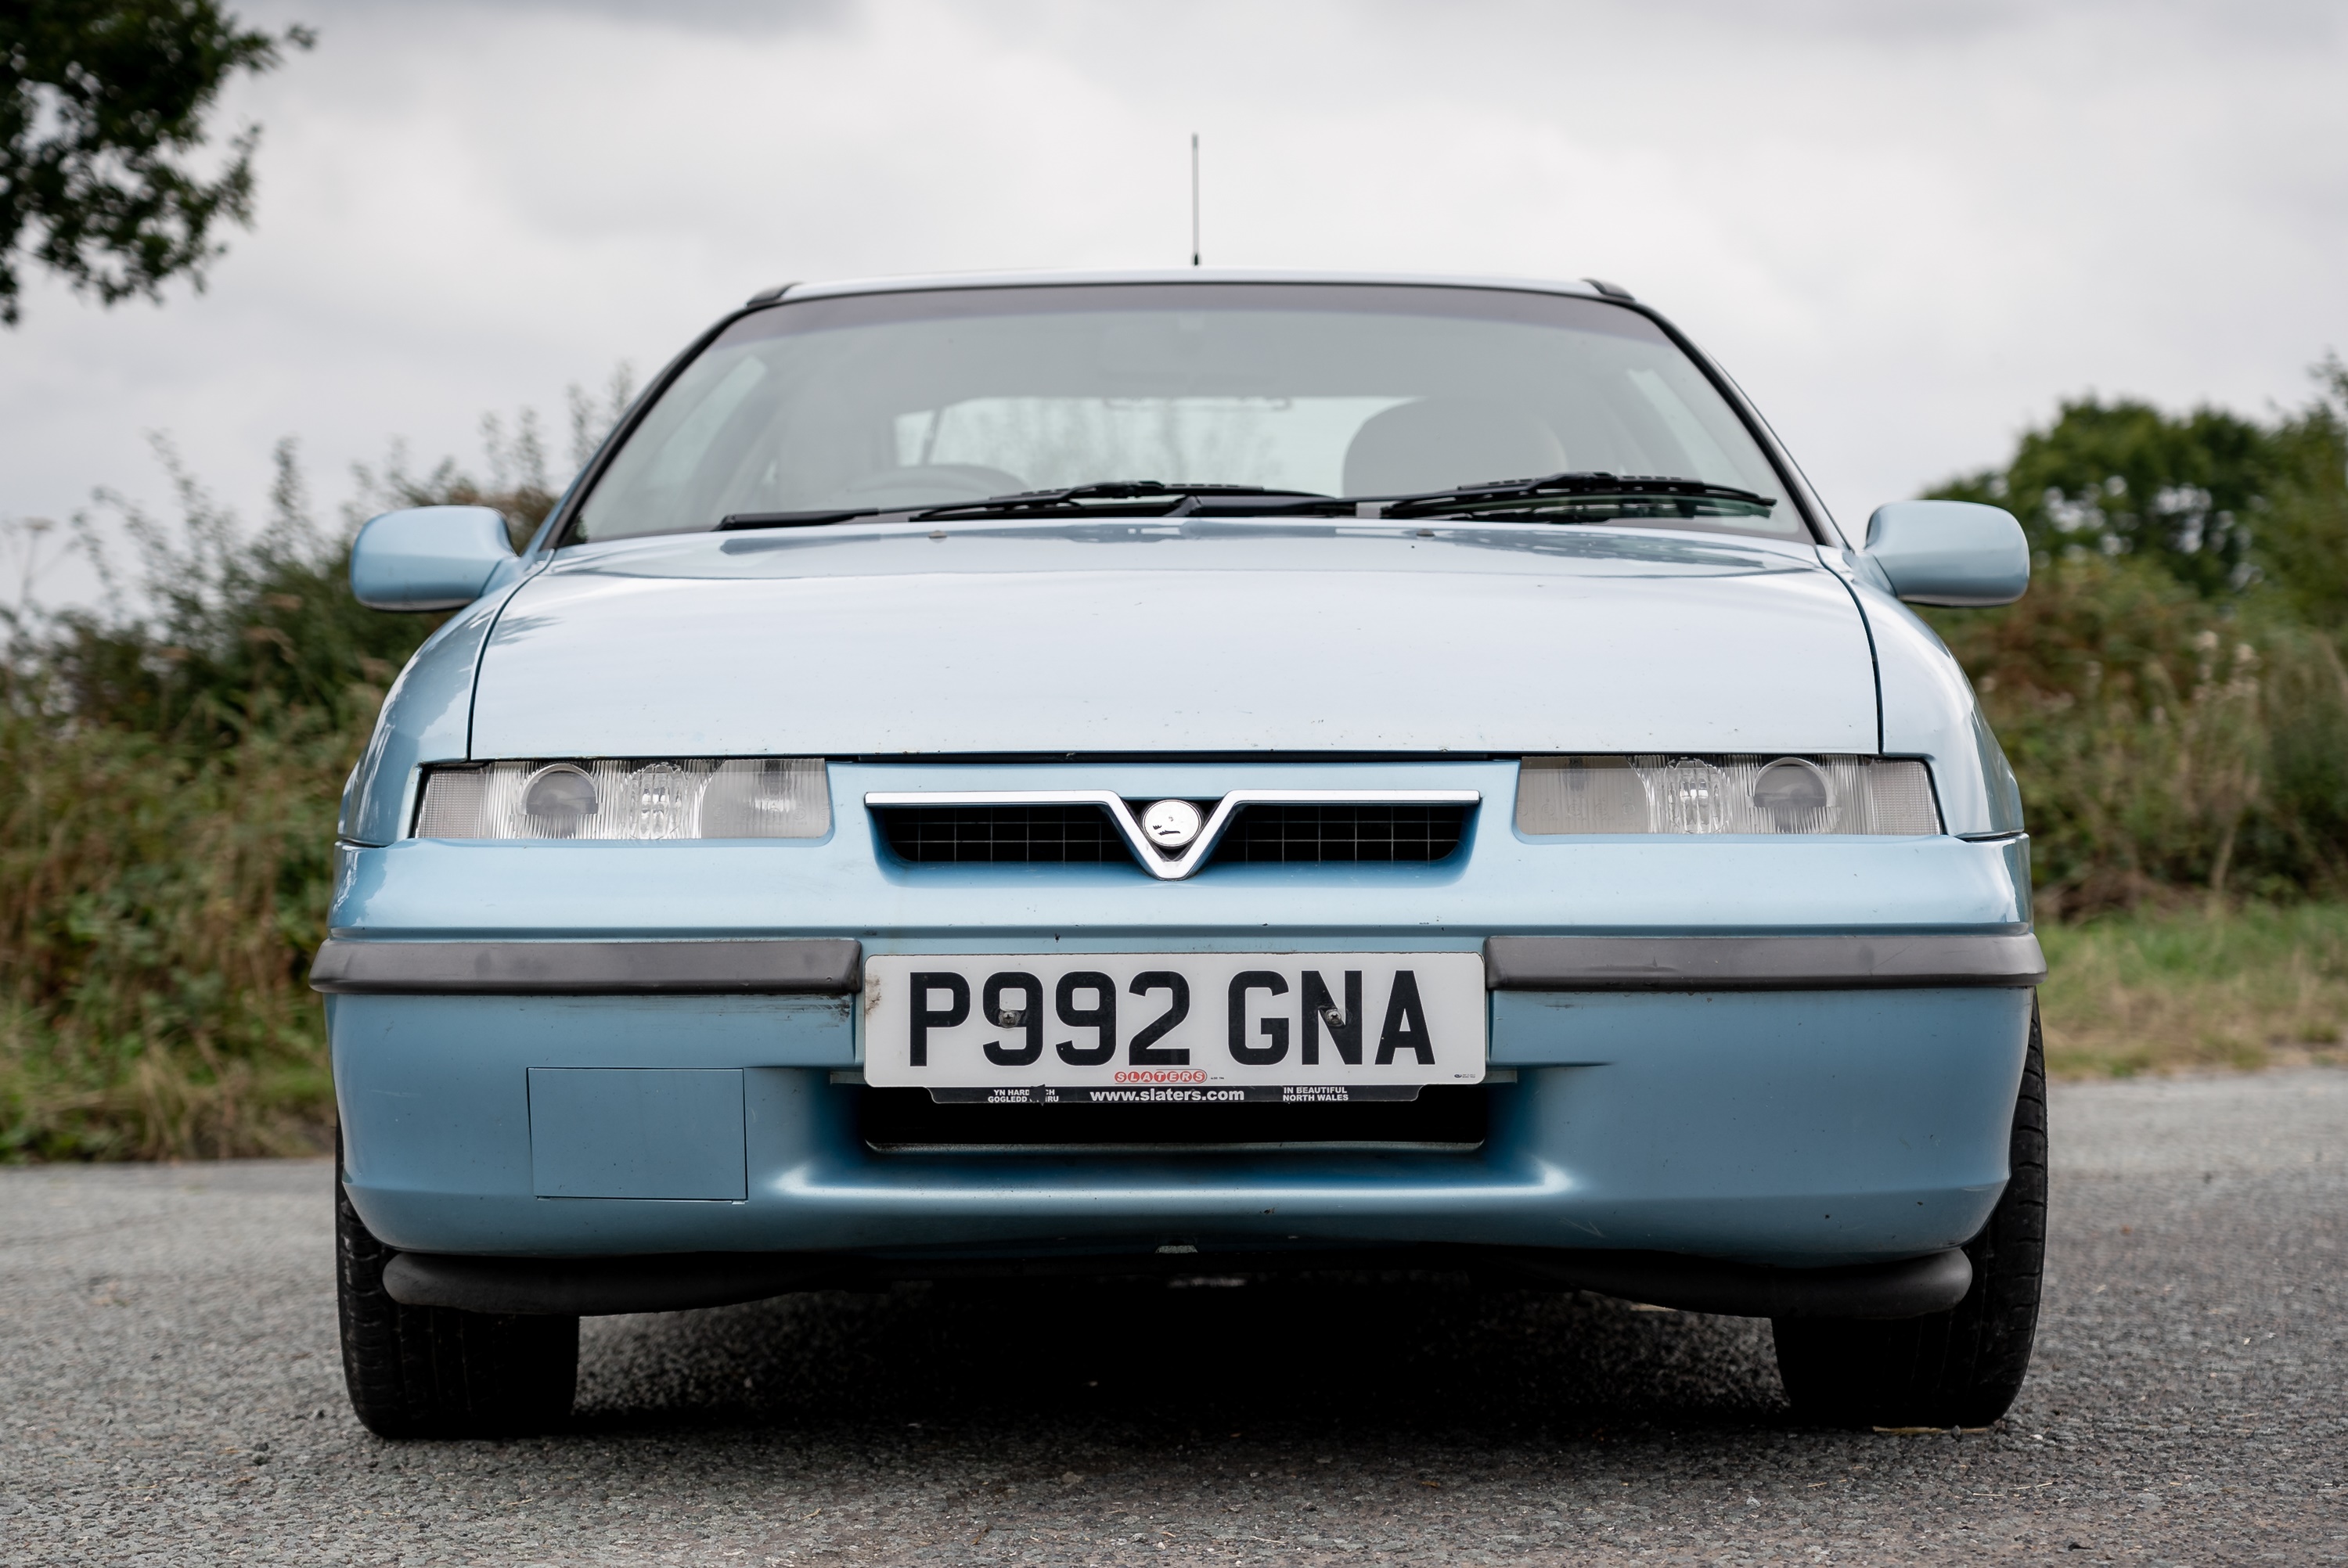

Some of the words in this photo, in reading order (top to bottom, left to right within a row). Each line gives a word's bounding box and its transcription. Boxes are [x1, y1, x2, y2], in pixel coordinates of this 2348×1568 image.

[909, 971, 1190, 1066] P992
[1228, 970, 1435, 1066] GNA
[1115, 1070, 1205, 1083] SLATERS
[1089, 1088, 1244, 1102] www.slaters.com
